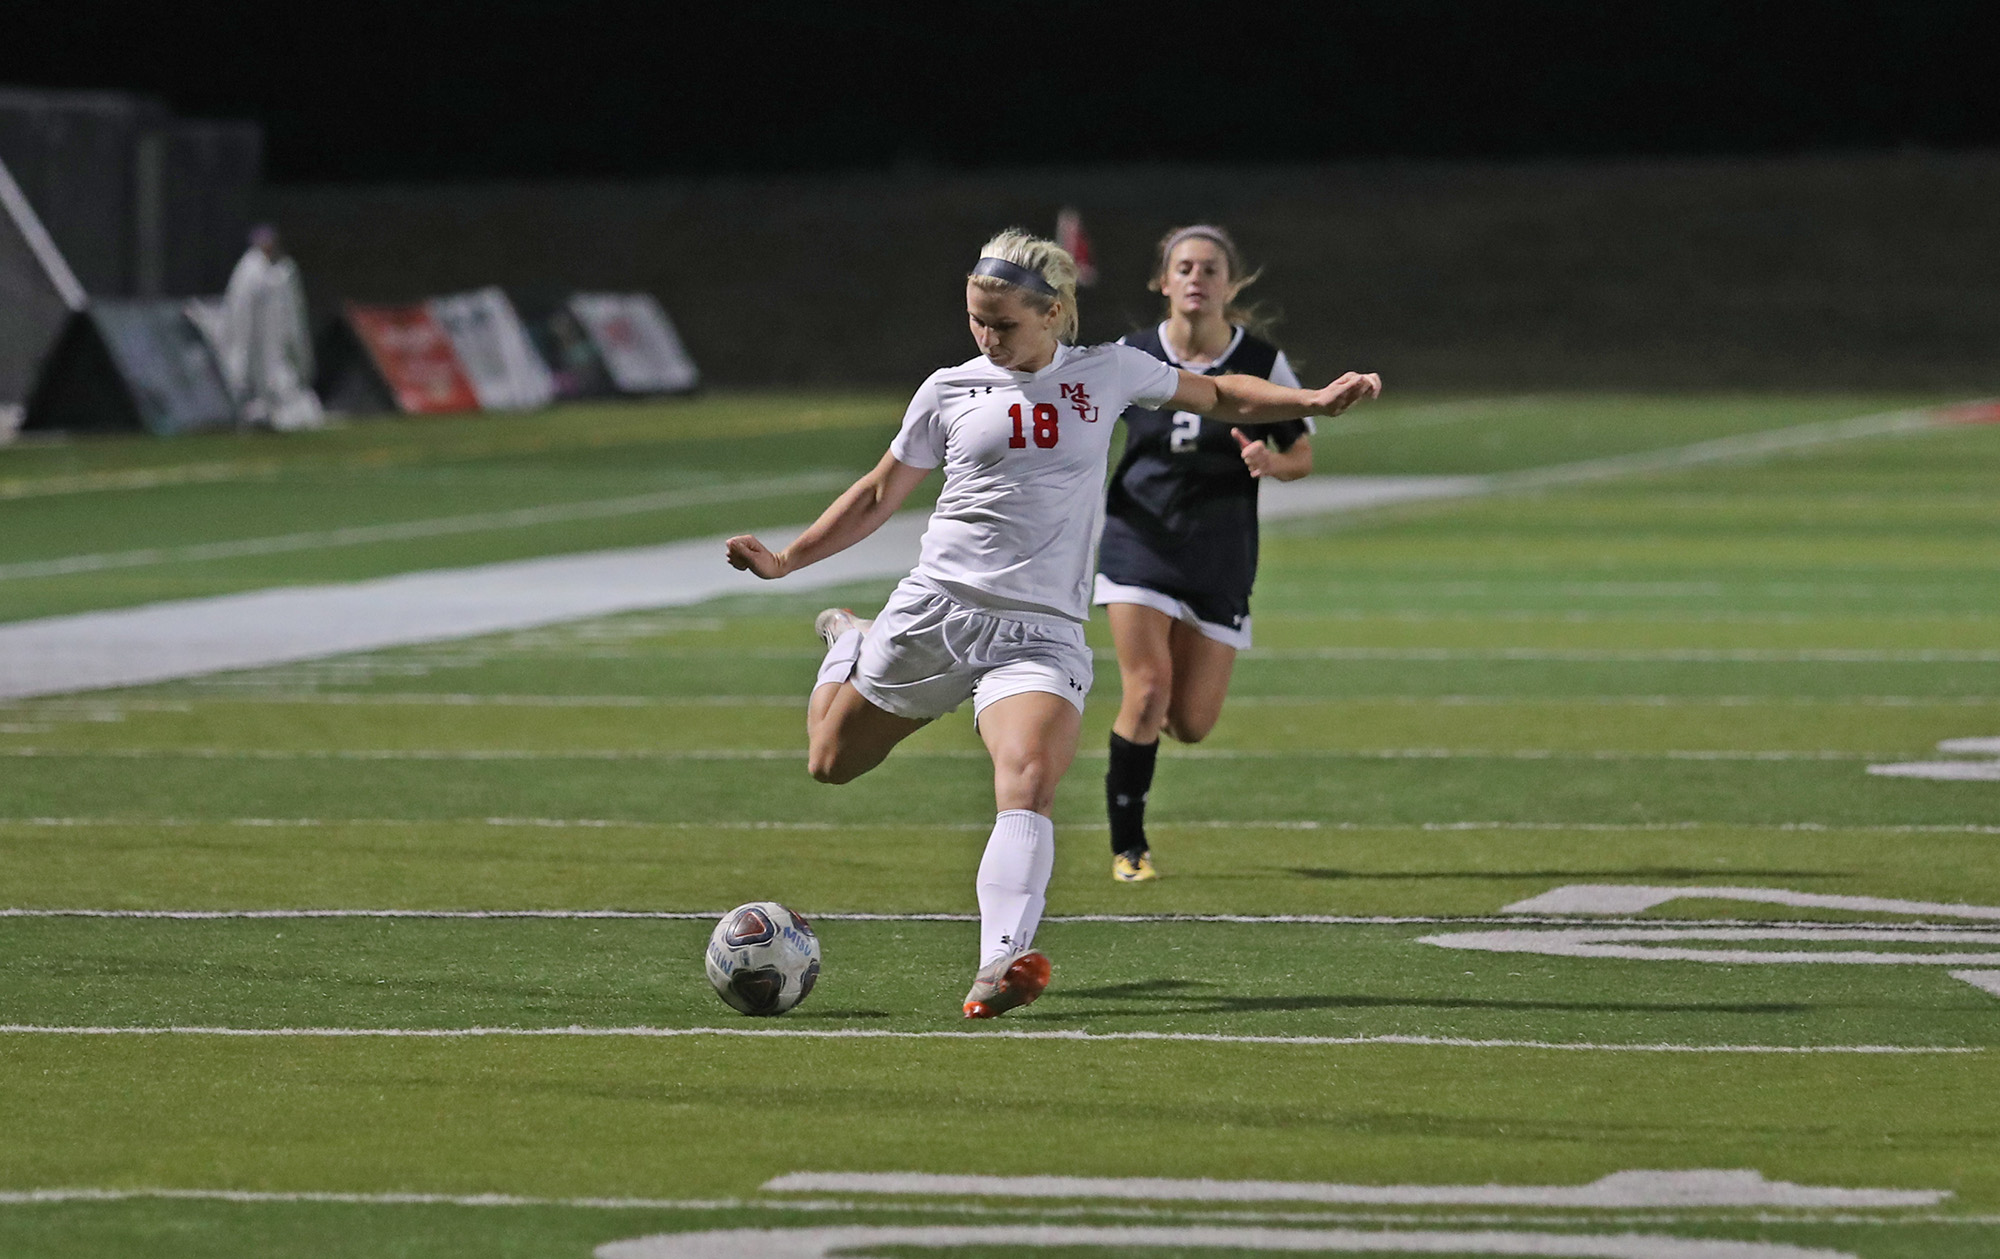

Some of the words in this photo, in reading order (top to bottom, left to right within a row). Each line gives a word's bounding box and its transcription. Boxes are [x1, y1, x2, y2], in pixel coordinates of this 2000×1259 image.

[1058, 383, 1099, 423] MSU
[1008, 402, 1059, 449] 18
[1170, 410, 1201, 453] 2
